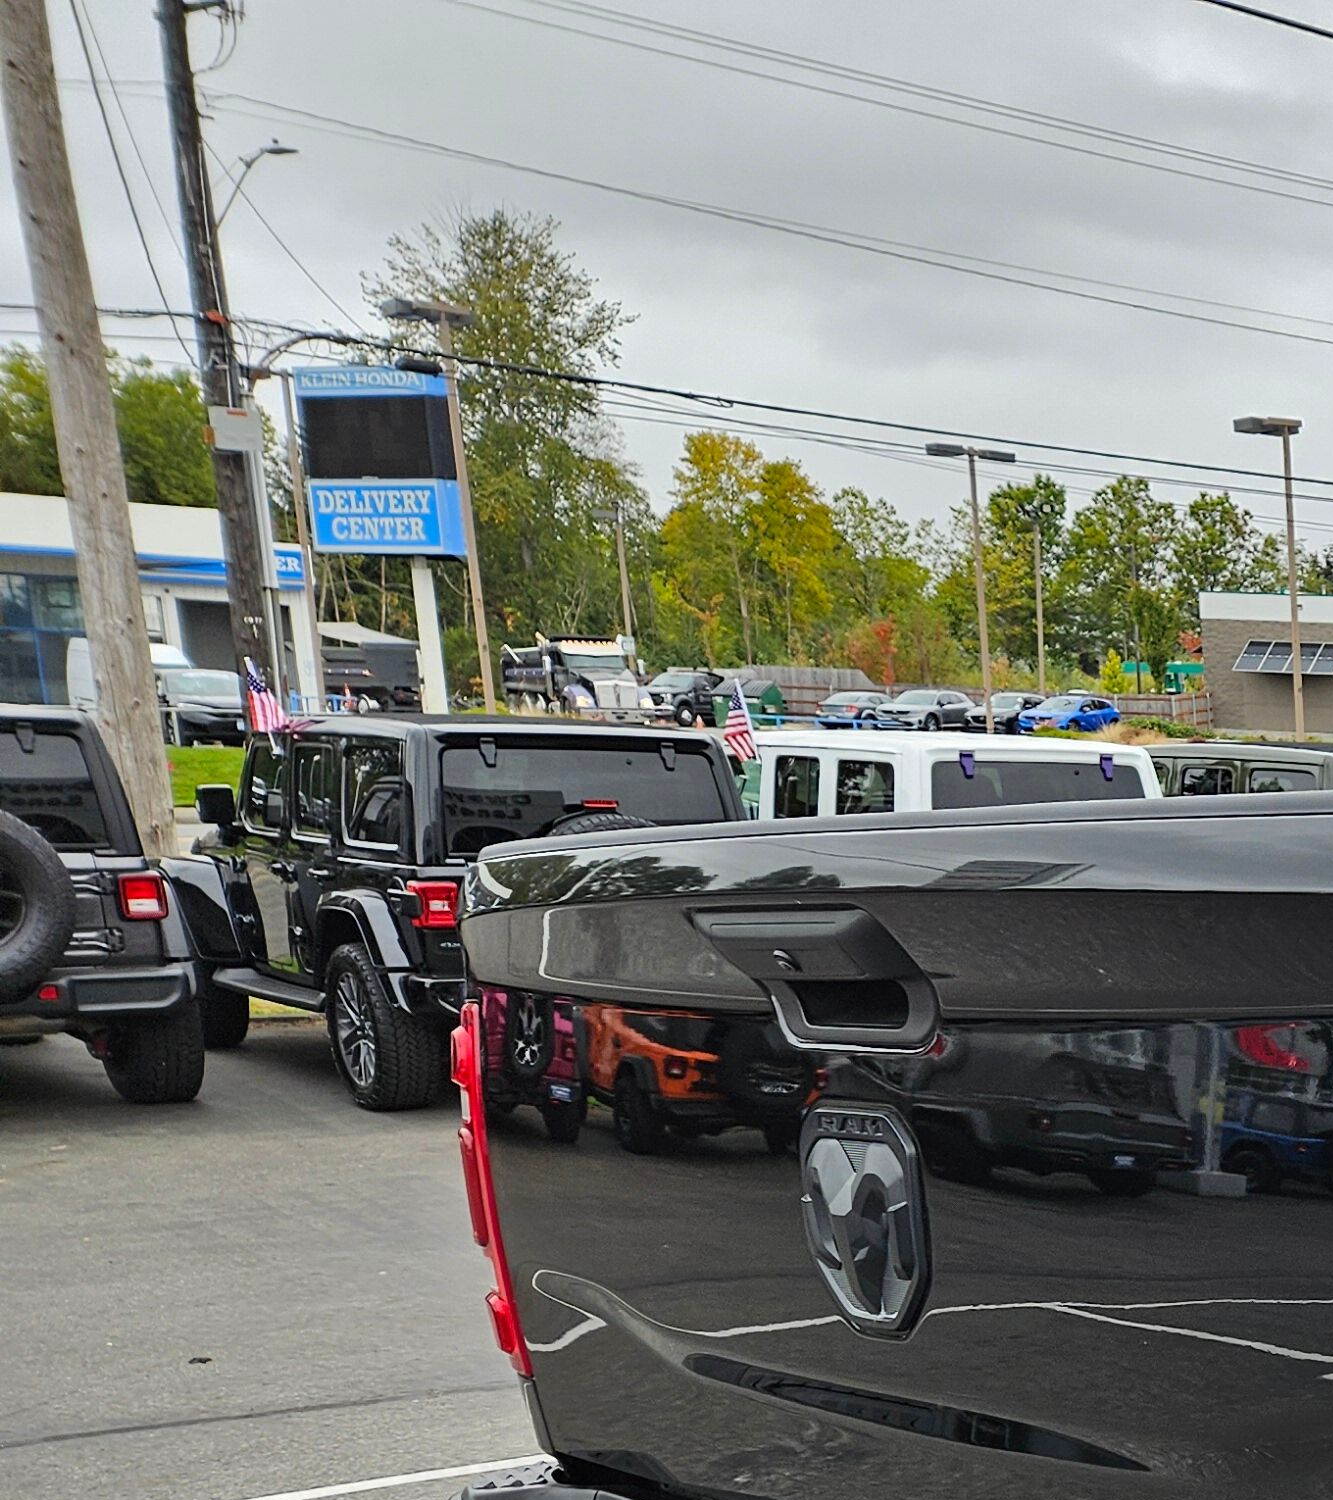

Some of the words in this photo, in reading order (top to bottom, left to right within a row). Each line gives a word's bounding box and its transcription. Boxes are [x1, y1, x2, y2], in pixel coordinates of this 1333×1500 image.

[300, 373, 351, 388] KLEIN
[354, 371, 423, 386] HONDA
[316, 489, 431, 515] DELIVERY
[331, 517, 427, 541] CENTER
[817, 1115, 884, 1137] RAM
